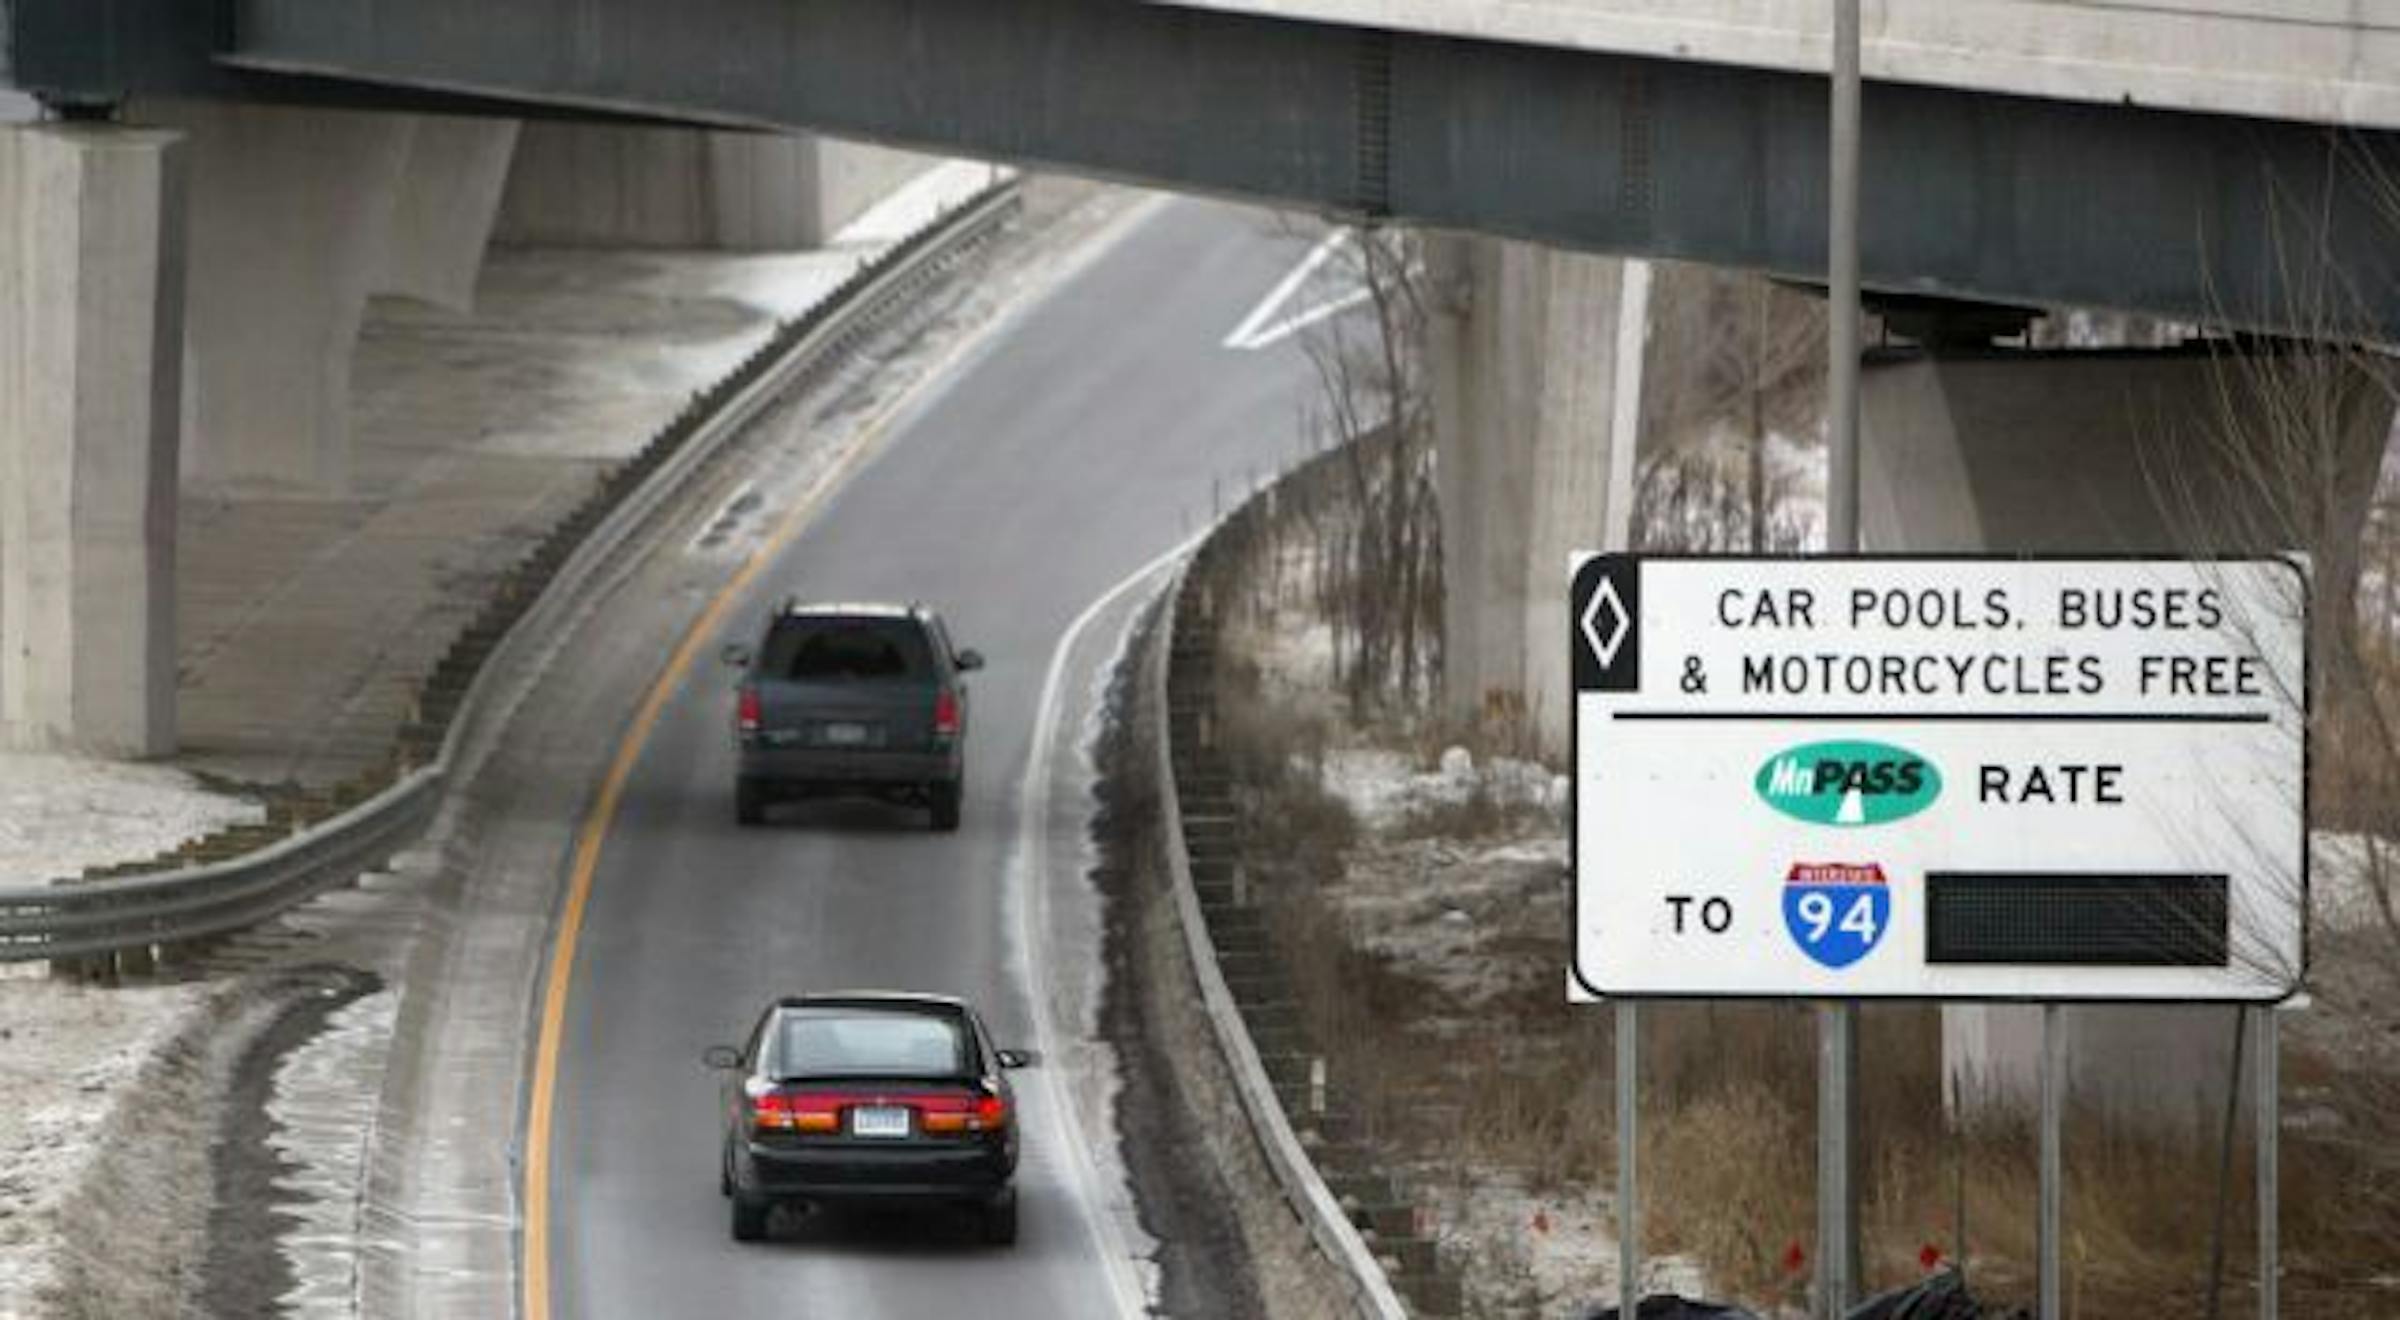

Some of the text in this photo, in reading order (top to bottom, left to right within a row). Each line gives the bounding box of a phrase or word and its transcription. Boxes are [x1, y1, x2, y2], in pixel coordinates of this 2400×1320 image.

[1718, 588, 1815, 628] CAR
[2059, 588, 2223, 629] BUSES
[1679, 655, 2263, 696] & MOTORCYCLES FREE
[1979, 764, 2124, 804] RATE
[1664, 892, 1876, 943] TO 94
